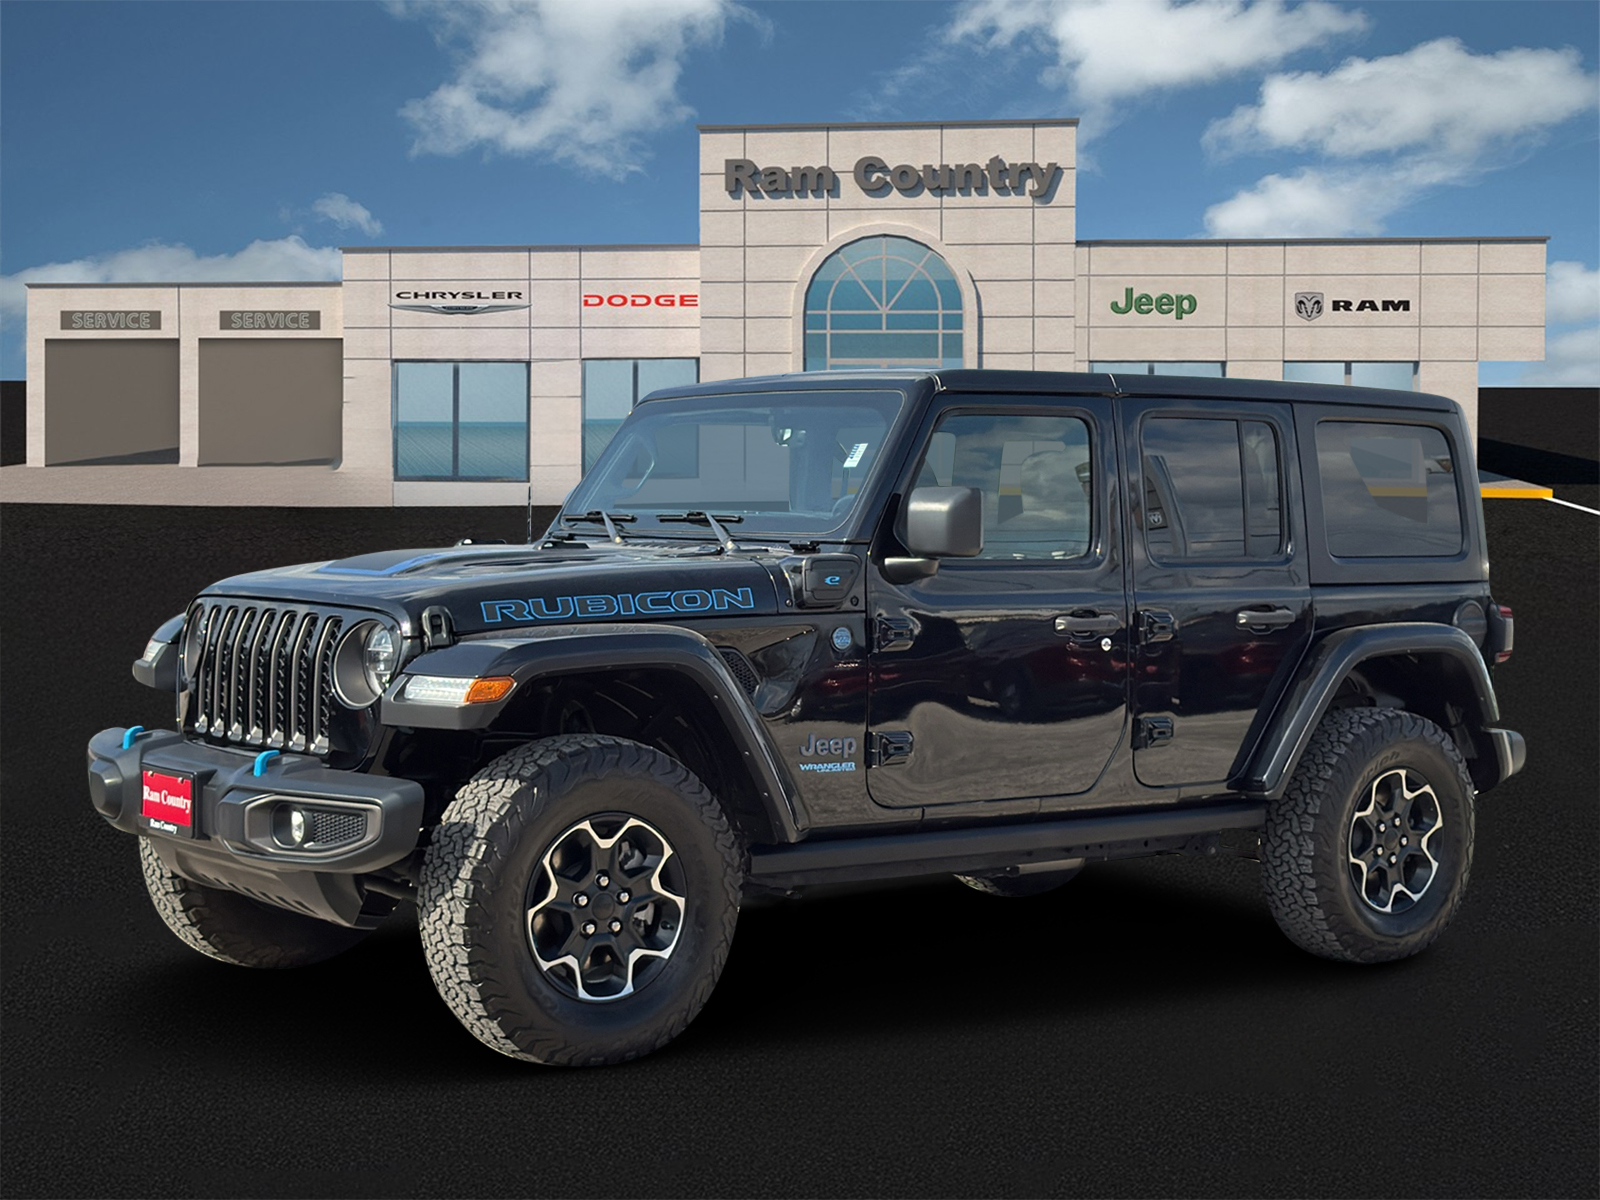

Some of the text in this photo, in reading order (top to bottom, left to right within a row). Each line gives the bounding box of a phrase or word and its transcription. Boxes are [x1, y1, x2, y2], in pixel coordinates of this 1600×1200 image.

[724, 154, 1058, 197] Ram Country
[395, 290, 523, 300] CHRYSLER
[583, 294, 699, 307] DODGE
[1110, 286, 1198, 320] Jeep
[1331, 299, 1411, 312] RAM
[71, 311, 151, 329] SERVICE
[230, 311, 310, 329] SERVICE
[480, 587, 755, 623] RUBICON
[800, 732, 857, 759] Jeep
[799, 761, 856, 771] WRANGLER
[143, 785, 192, 814] Ram Country
